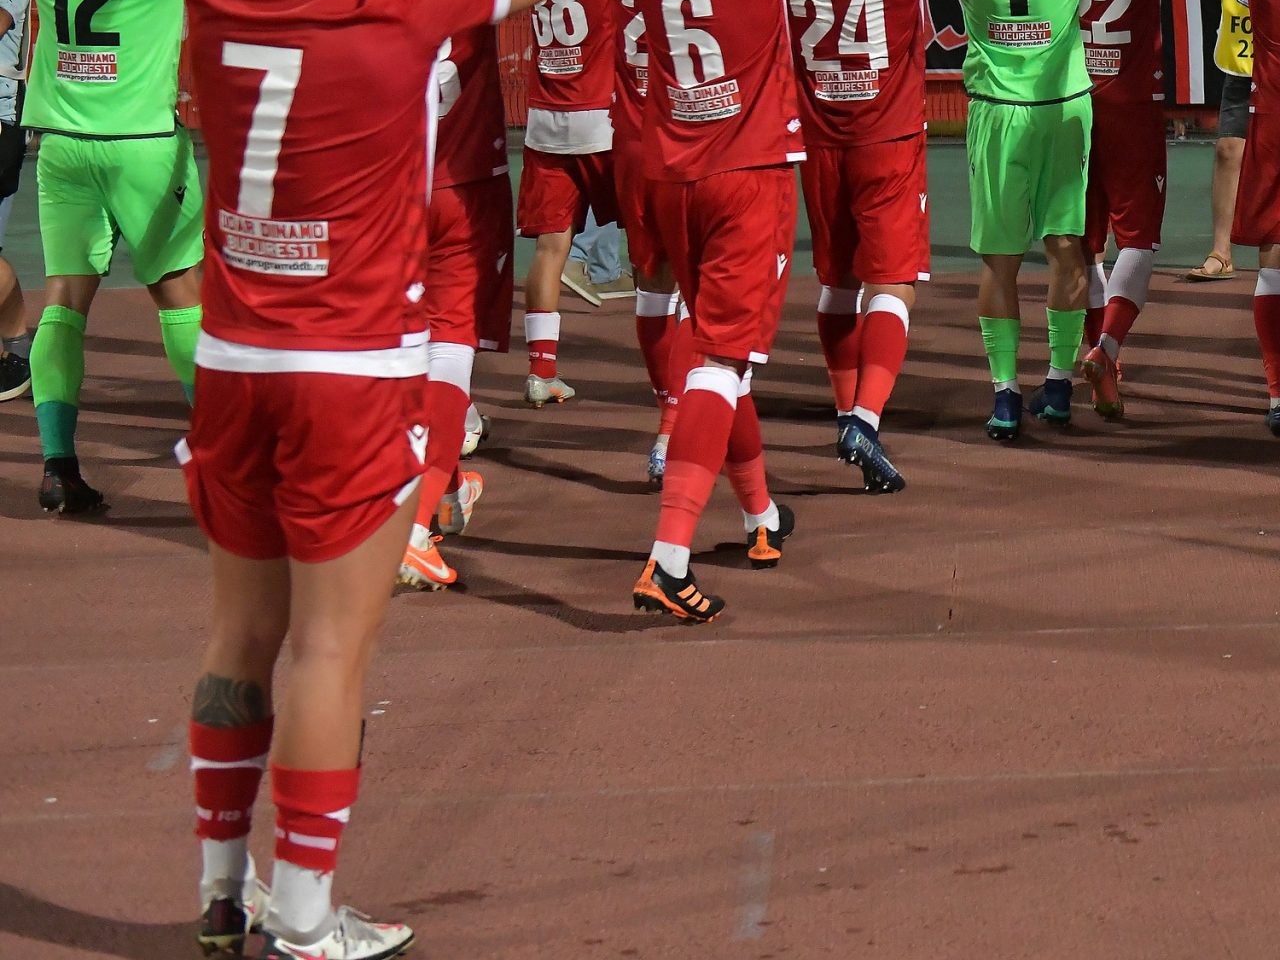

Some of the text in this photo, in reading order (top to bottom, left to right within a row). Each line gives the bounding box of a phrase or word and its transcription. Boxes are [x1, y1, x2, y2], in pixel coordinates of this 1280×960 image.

[989, 21, 1050, 31] DOAR DINAMO
[994, 31, 1046, 41] BUCURESTI
[58, 51, 116, 63] DOAR DINAMO
[554, 47, 580, 57] DINAMO
[1090, 49, 1120, 59] DINAMO
[61, 62, 112, 74] BUCURESTI
[816, 71, 877, 82] DOAR DINAMO
[694, 82, 737, 99] DINAMO
[822, 81, 874, 92] BUCURESTI
[674, 96, 734, 112] BUCURESTI
[222, 41, 304, 219] 7
[260, 221, 324, 239] DINAMO
[226, 234, 318, 258] BUCURESTI
